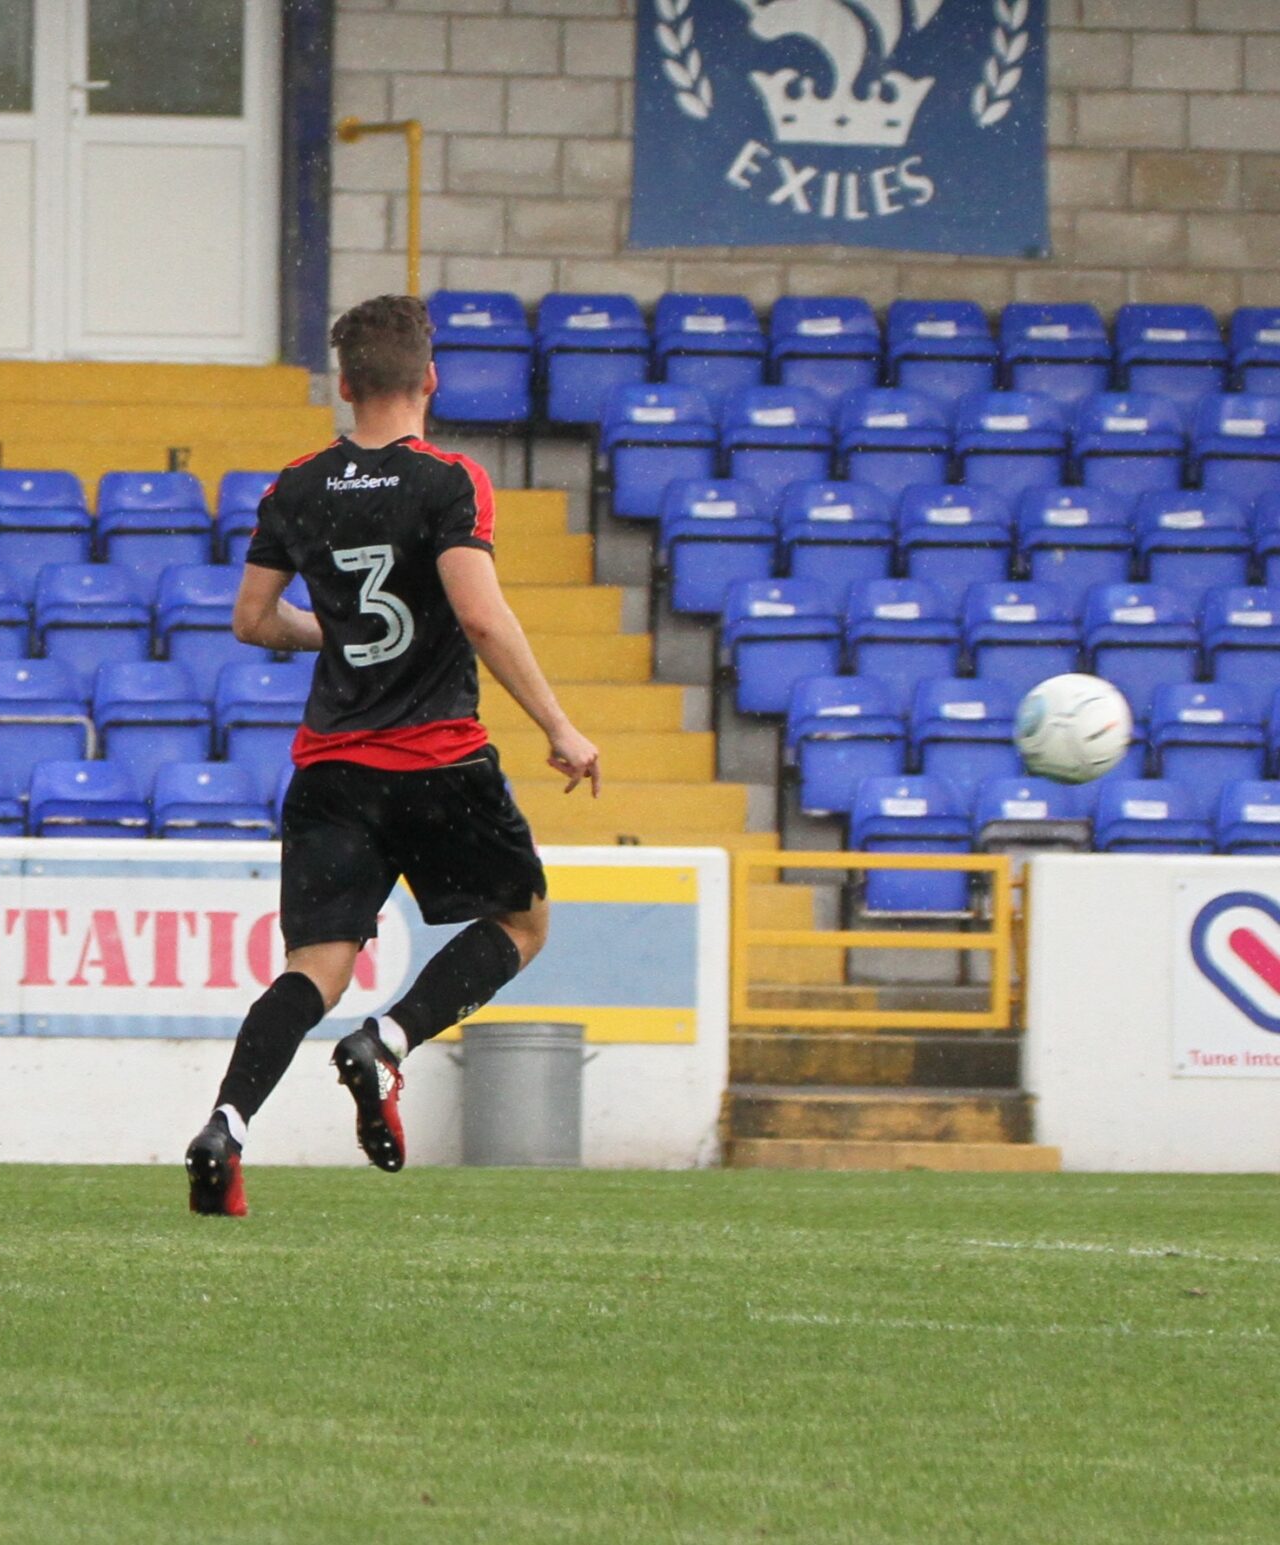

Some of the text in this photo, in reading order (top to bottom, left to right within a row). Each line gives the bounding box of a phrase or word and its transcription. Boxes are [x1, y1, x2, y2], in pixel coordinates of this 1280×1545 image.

[726, 139, 935, 221] EXILES
[326, 474, 400, 491] HomeServe
[332, 544, 415, 667] 3
[1187, 1050, 1238, 1066] Tune
